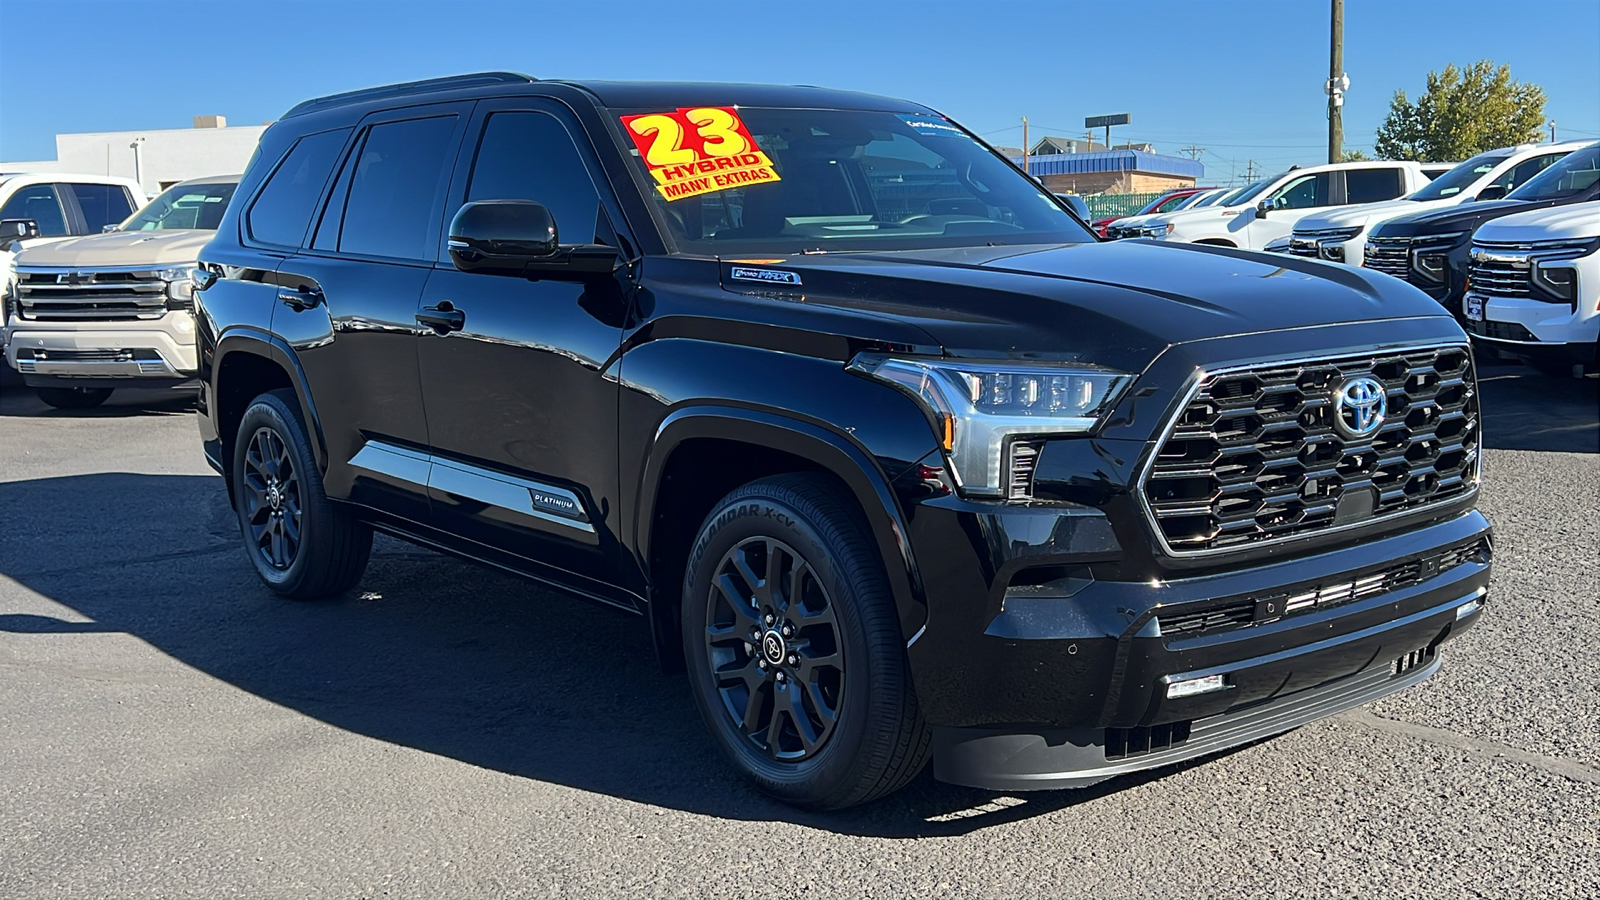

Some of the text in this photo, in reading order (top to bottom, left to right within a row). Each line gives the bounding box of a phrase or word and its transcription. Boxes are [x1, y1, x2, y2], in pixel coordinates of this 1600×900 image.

[629, 108, 751, 166] 23
[662, 153, 762, 181] HYBRID
[664, 168, 772, 198] MANY EXTRAS
[535, 494, 573, 508] PLATINUM
[687, 504, 760, 587] GEOLANDAR
